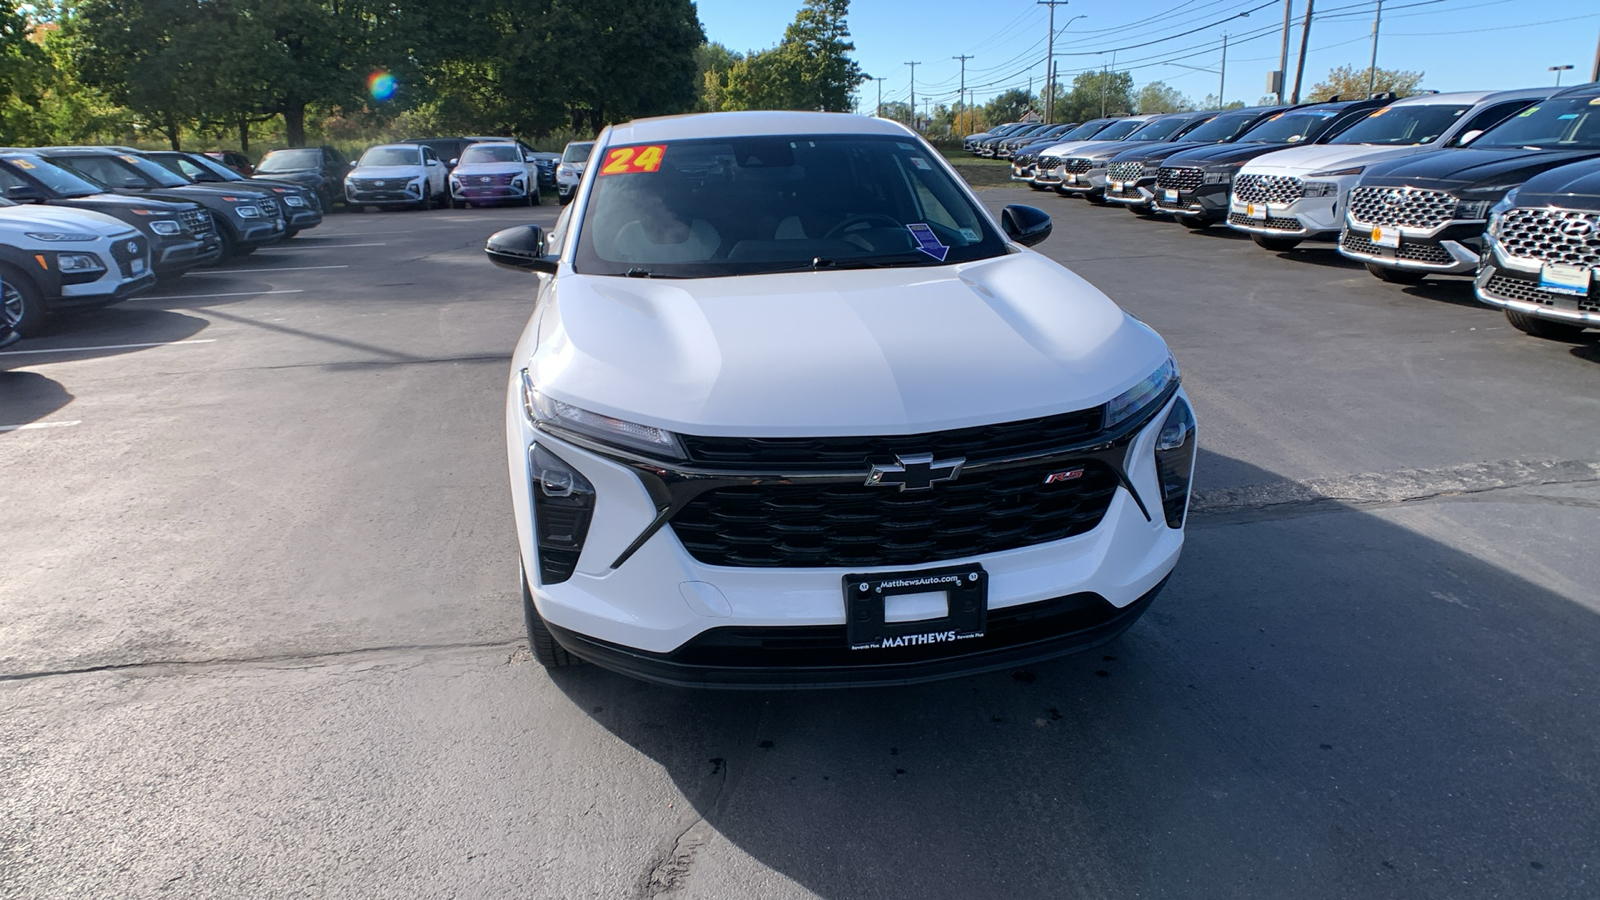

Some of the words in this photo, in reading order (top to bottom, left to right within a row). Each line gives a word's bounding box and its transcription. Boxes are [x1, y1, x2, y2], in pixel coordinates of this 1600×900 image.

[603, 146, 663, 173] 24
[1045, 468, 1085, 484] RS
[880, 576, 958, 588] MatthewsAuto.com
[881, 631, 956, 649] MATTHEWS
